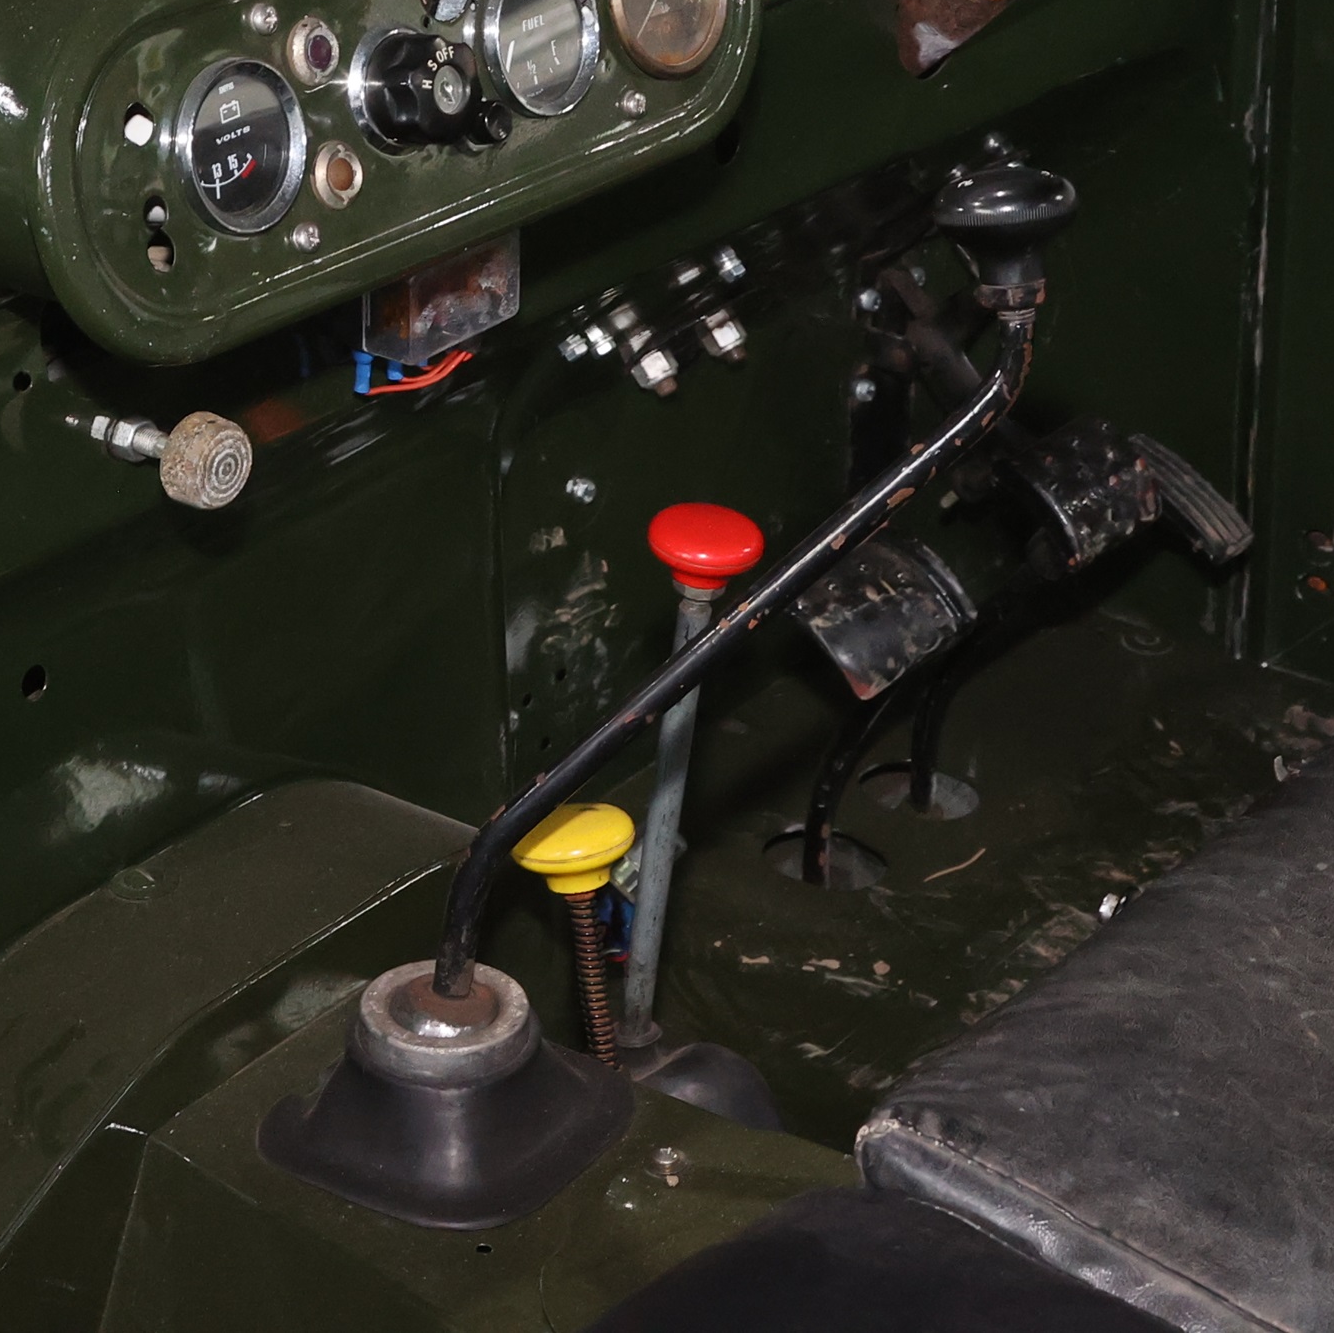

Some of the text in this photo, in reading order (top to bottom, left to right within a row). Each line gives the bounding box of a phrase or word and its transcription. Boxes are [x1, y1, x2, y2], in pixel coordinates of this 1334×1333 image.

[522, 14, 545, 33] FUEL
[435, 45, 455, 64] OFF
[550, 39, 557, 56] F
[427, 59, 438, 72] S
[421, 78, 433, 90] H
[215, 125, 251, 146] VOLTS
[211, 162, 223, 180] 13
[227, 153, 239, 171] 15
